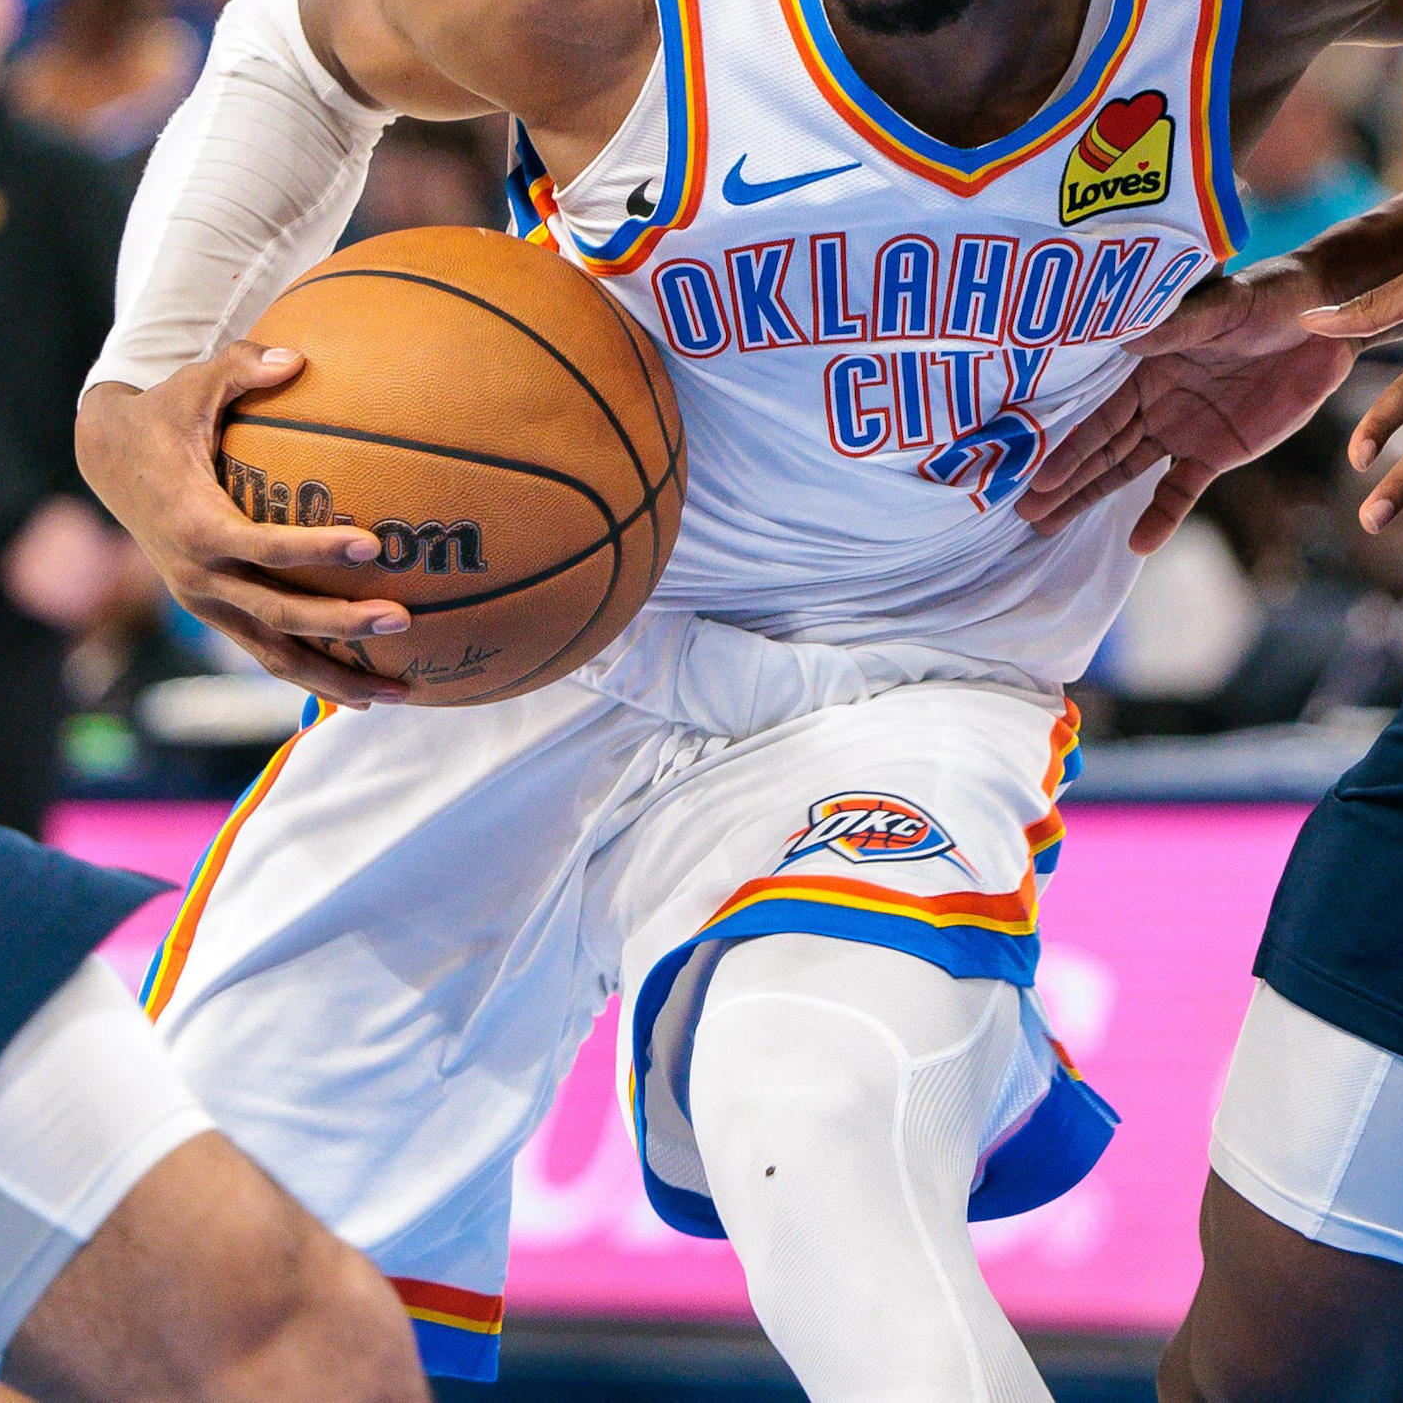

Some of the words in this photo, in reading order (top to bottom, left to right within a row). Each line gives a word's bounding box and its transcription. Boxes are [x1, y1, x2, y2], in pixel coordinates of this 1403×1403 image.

[651, 232, 1210, 358] OKLAHOMA
[825, 346, 1052, 457] CITY
[216, 450, 488, 575] Wilon
